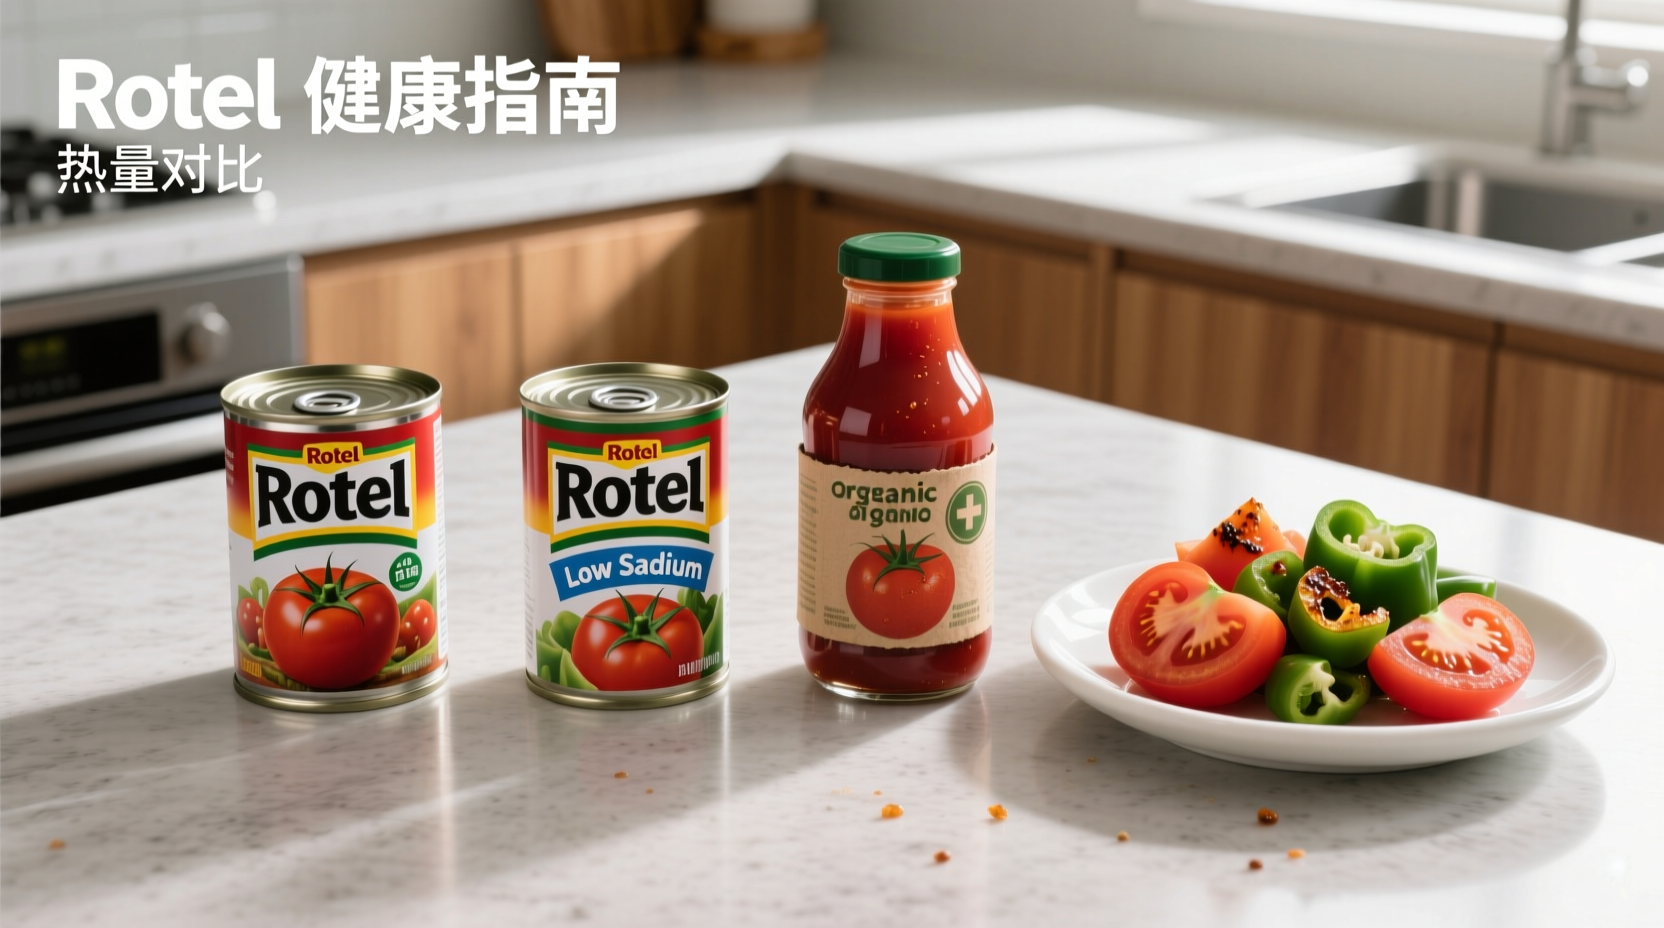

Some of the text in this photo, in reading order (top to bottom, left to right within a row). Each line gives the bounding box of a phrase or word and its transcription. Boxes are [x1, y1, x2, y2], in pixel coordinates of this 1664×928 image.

[307, 446, 360, 465] Rotel
[608, 443, 658, 461] Rotel
[255, 459, 410, 528] Rotel
[556, 456, 704, 522] Rotel
[564, 551, 703, 589] Low Sadium
